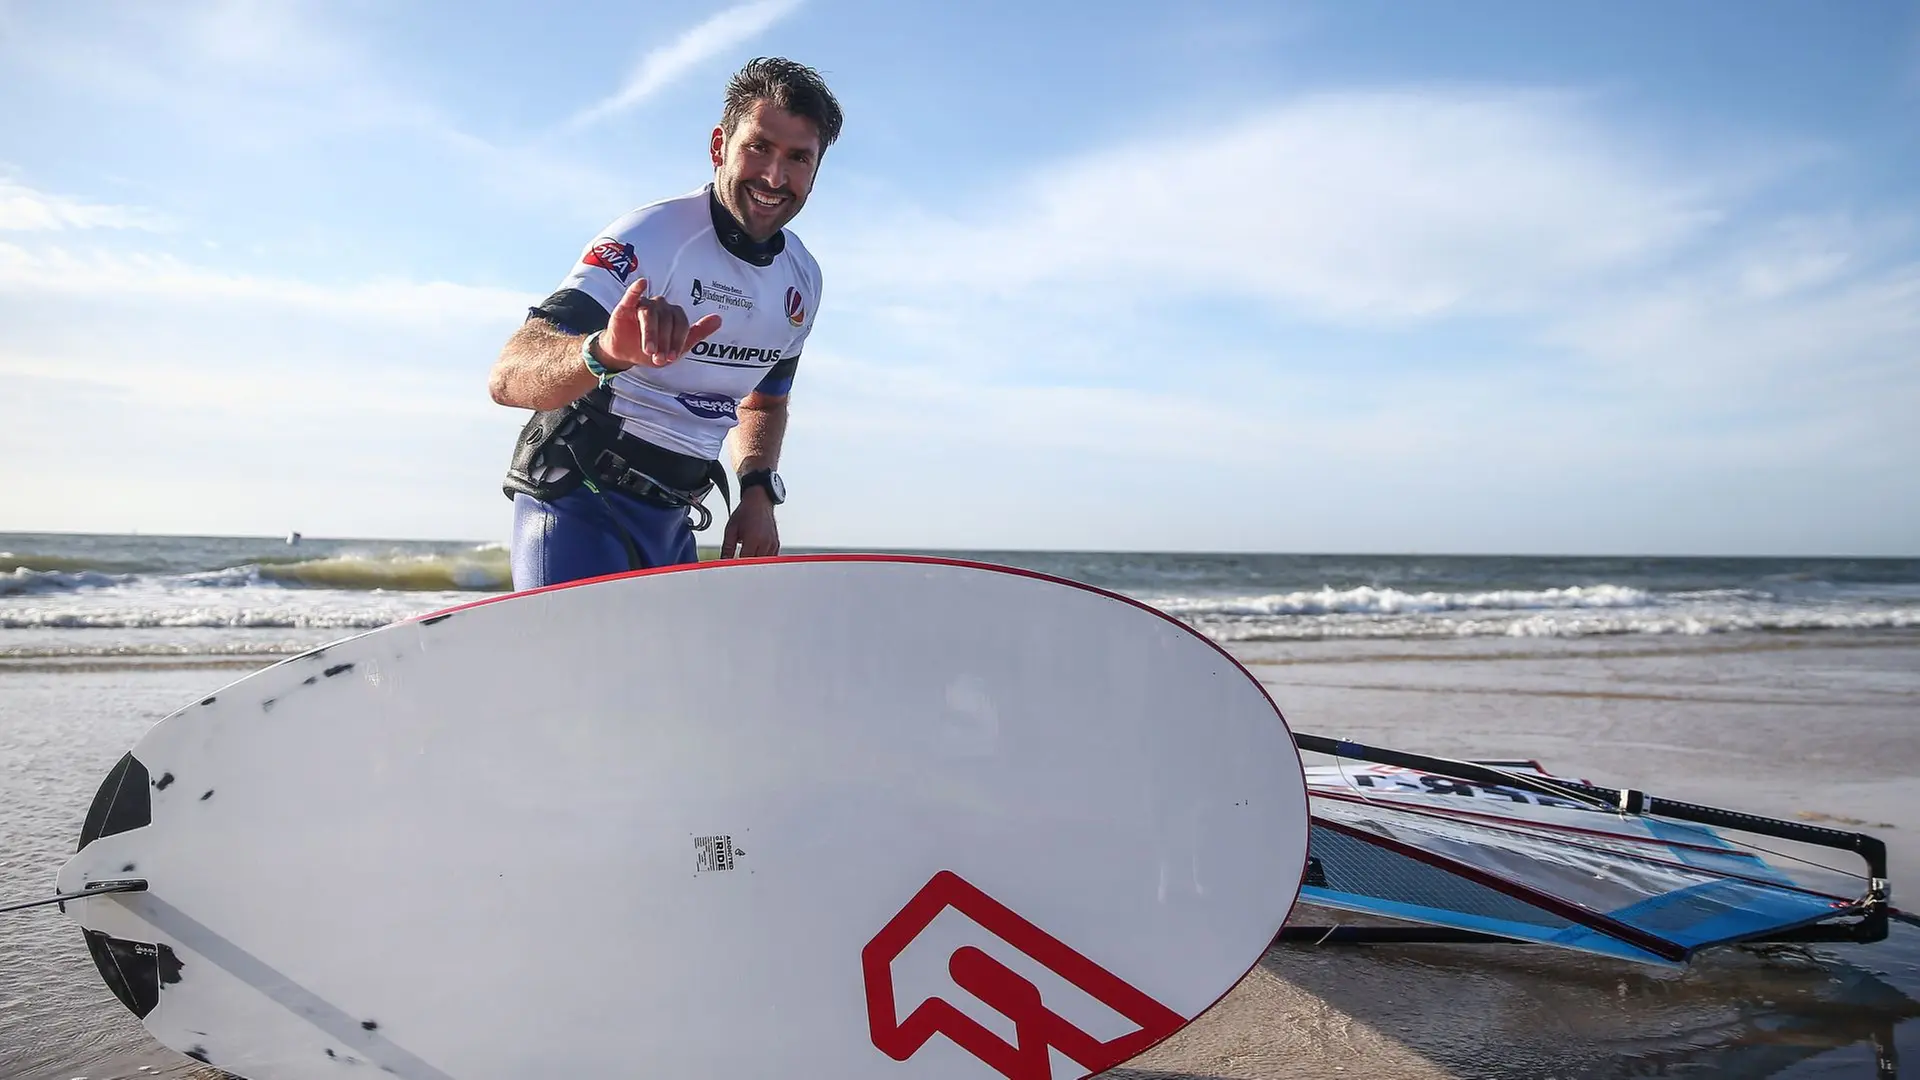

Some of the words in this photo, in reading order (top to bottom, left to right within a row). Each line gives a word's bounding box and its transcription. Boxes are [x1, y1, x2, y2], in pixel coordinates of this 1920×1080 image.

[703, 290, 725, 304] Windsurf
[725, 295, 741, 308] World
[741, 298, 754, 311] Cup
[690, 341, 782, 363] OLYMPUS
[715, 841, 726, 871] RIDE
